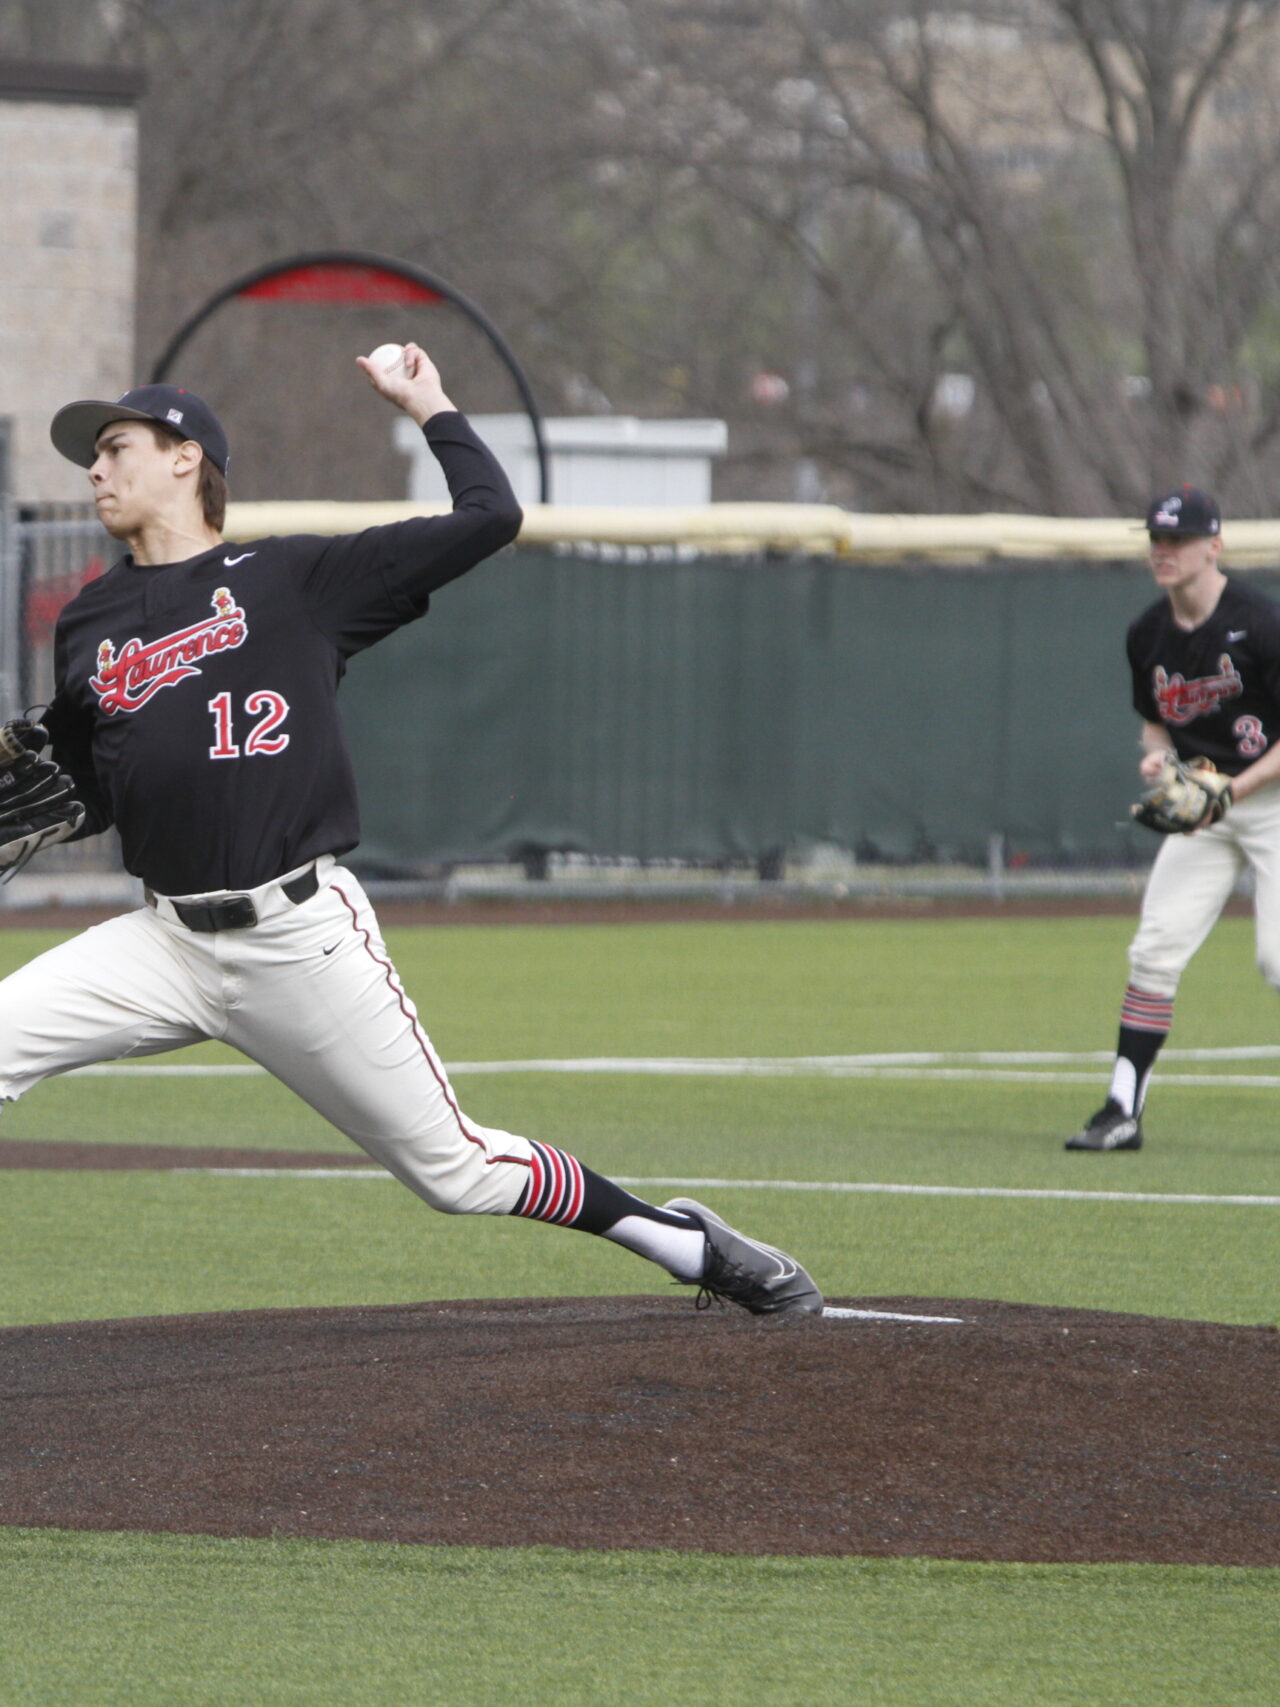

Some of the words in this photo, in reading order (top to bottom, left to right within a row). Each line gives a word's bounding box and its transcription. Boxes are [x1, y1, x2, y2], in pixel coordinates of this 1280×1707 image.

[89, 618, 248, 715] Lawrence
[208, 689, 290, 760] 12
[1233, 714, 1268, 757] 3
